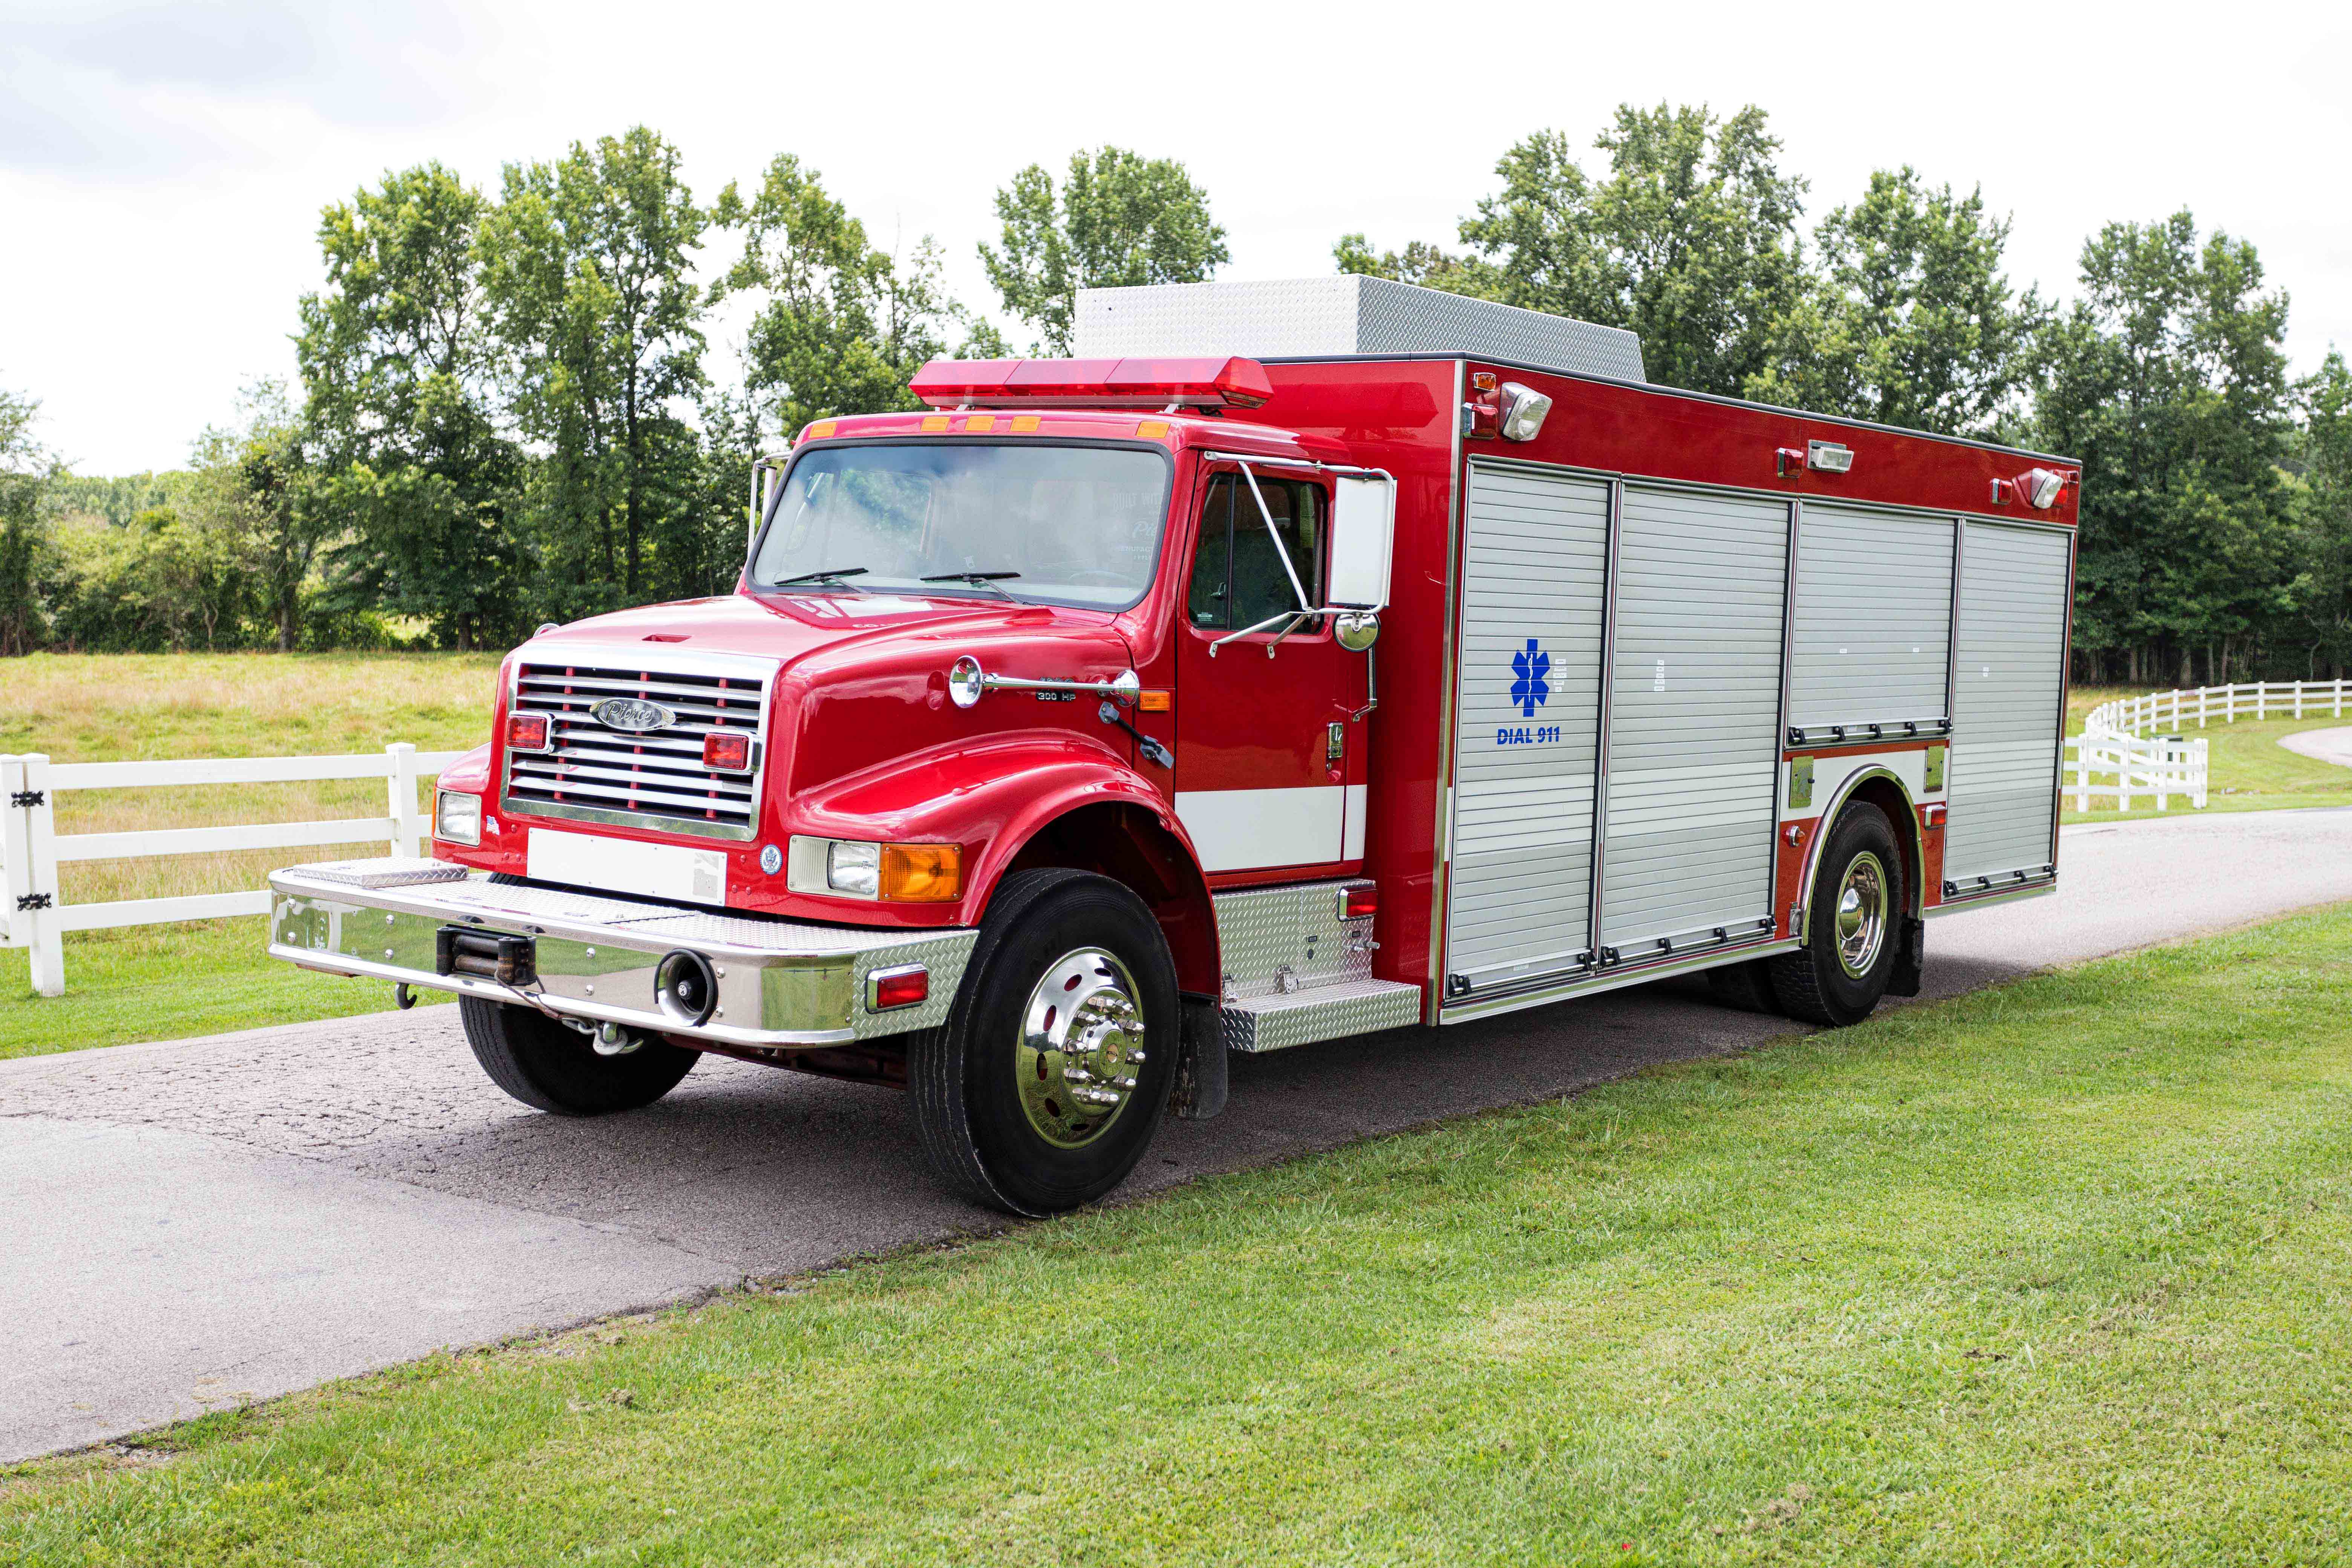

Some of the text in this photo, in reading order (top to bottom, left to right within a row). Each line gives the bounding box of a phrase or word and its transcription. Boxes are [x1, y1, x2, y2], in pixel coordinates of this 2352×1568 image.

[606, 701, 652, 722] Pierce
[1497, 726, 1560, 745] DIAL 911
